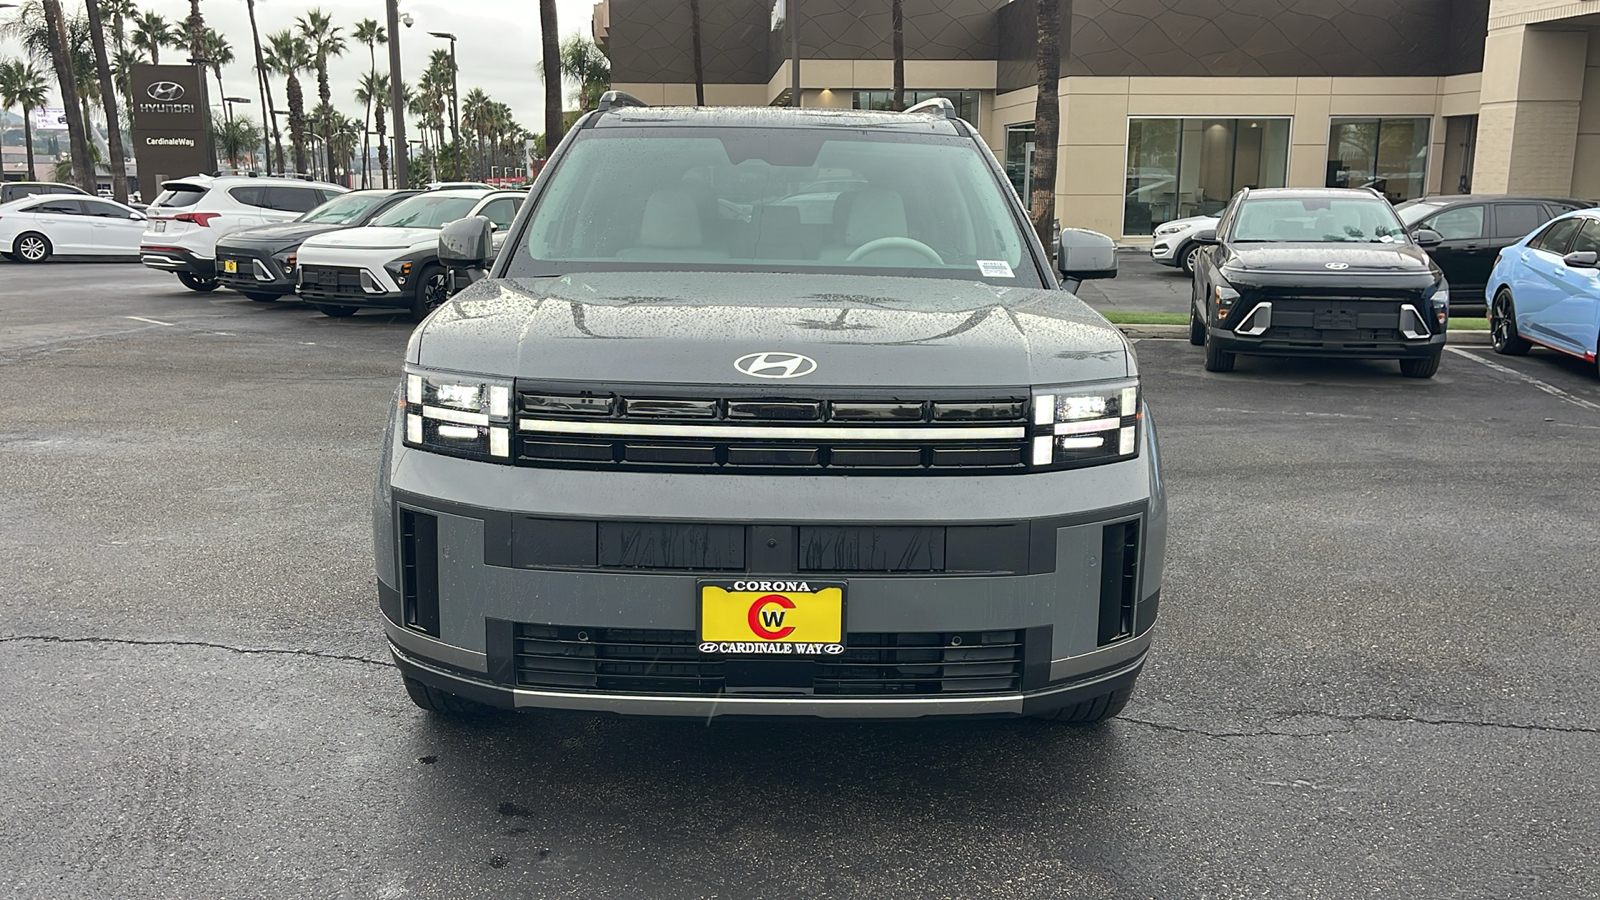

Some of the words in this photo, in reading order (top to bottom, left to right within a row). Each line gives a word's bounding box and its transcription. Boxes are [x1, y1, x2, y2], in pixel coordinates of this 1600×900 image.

[140, 104, 195, 113] HYUNDAI
[146, 137, 195, 147] CardinaleWay
[733, 581, 811, 592] CORONA
[719, 643, 792, 654] CARDINALE
[795, 643, 824, 655] WAY
